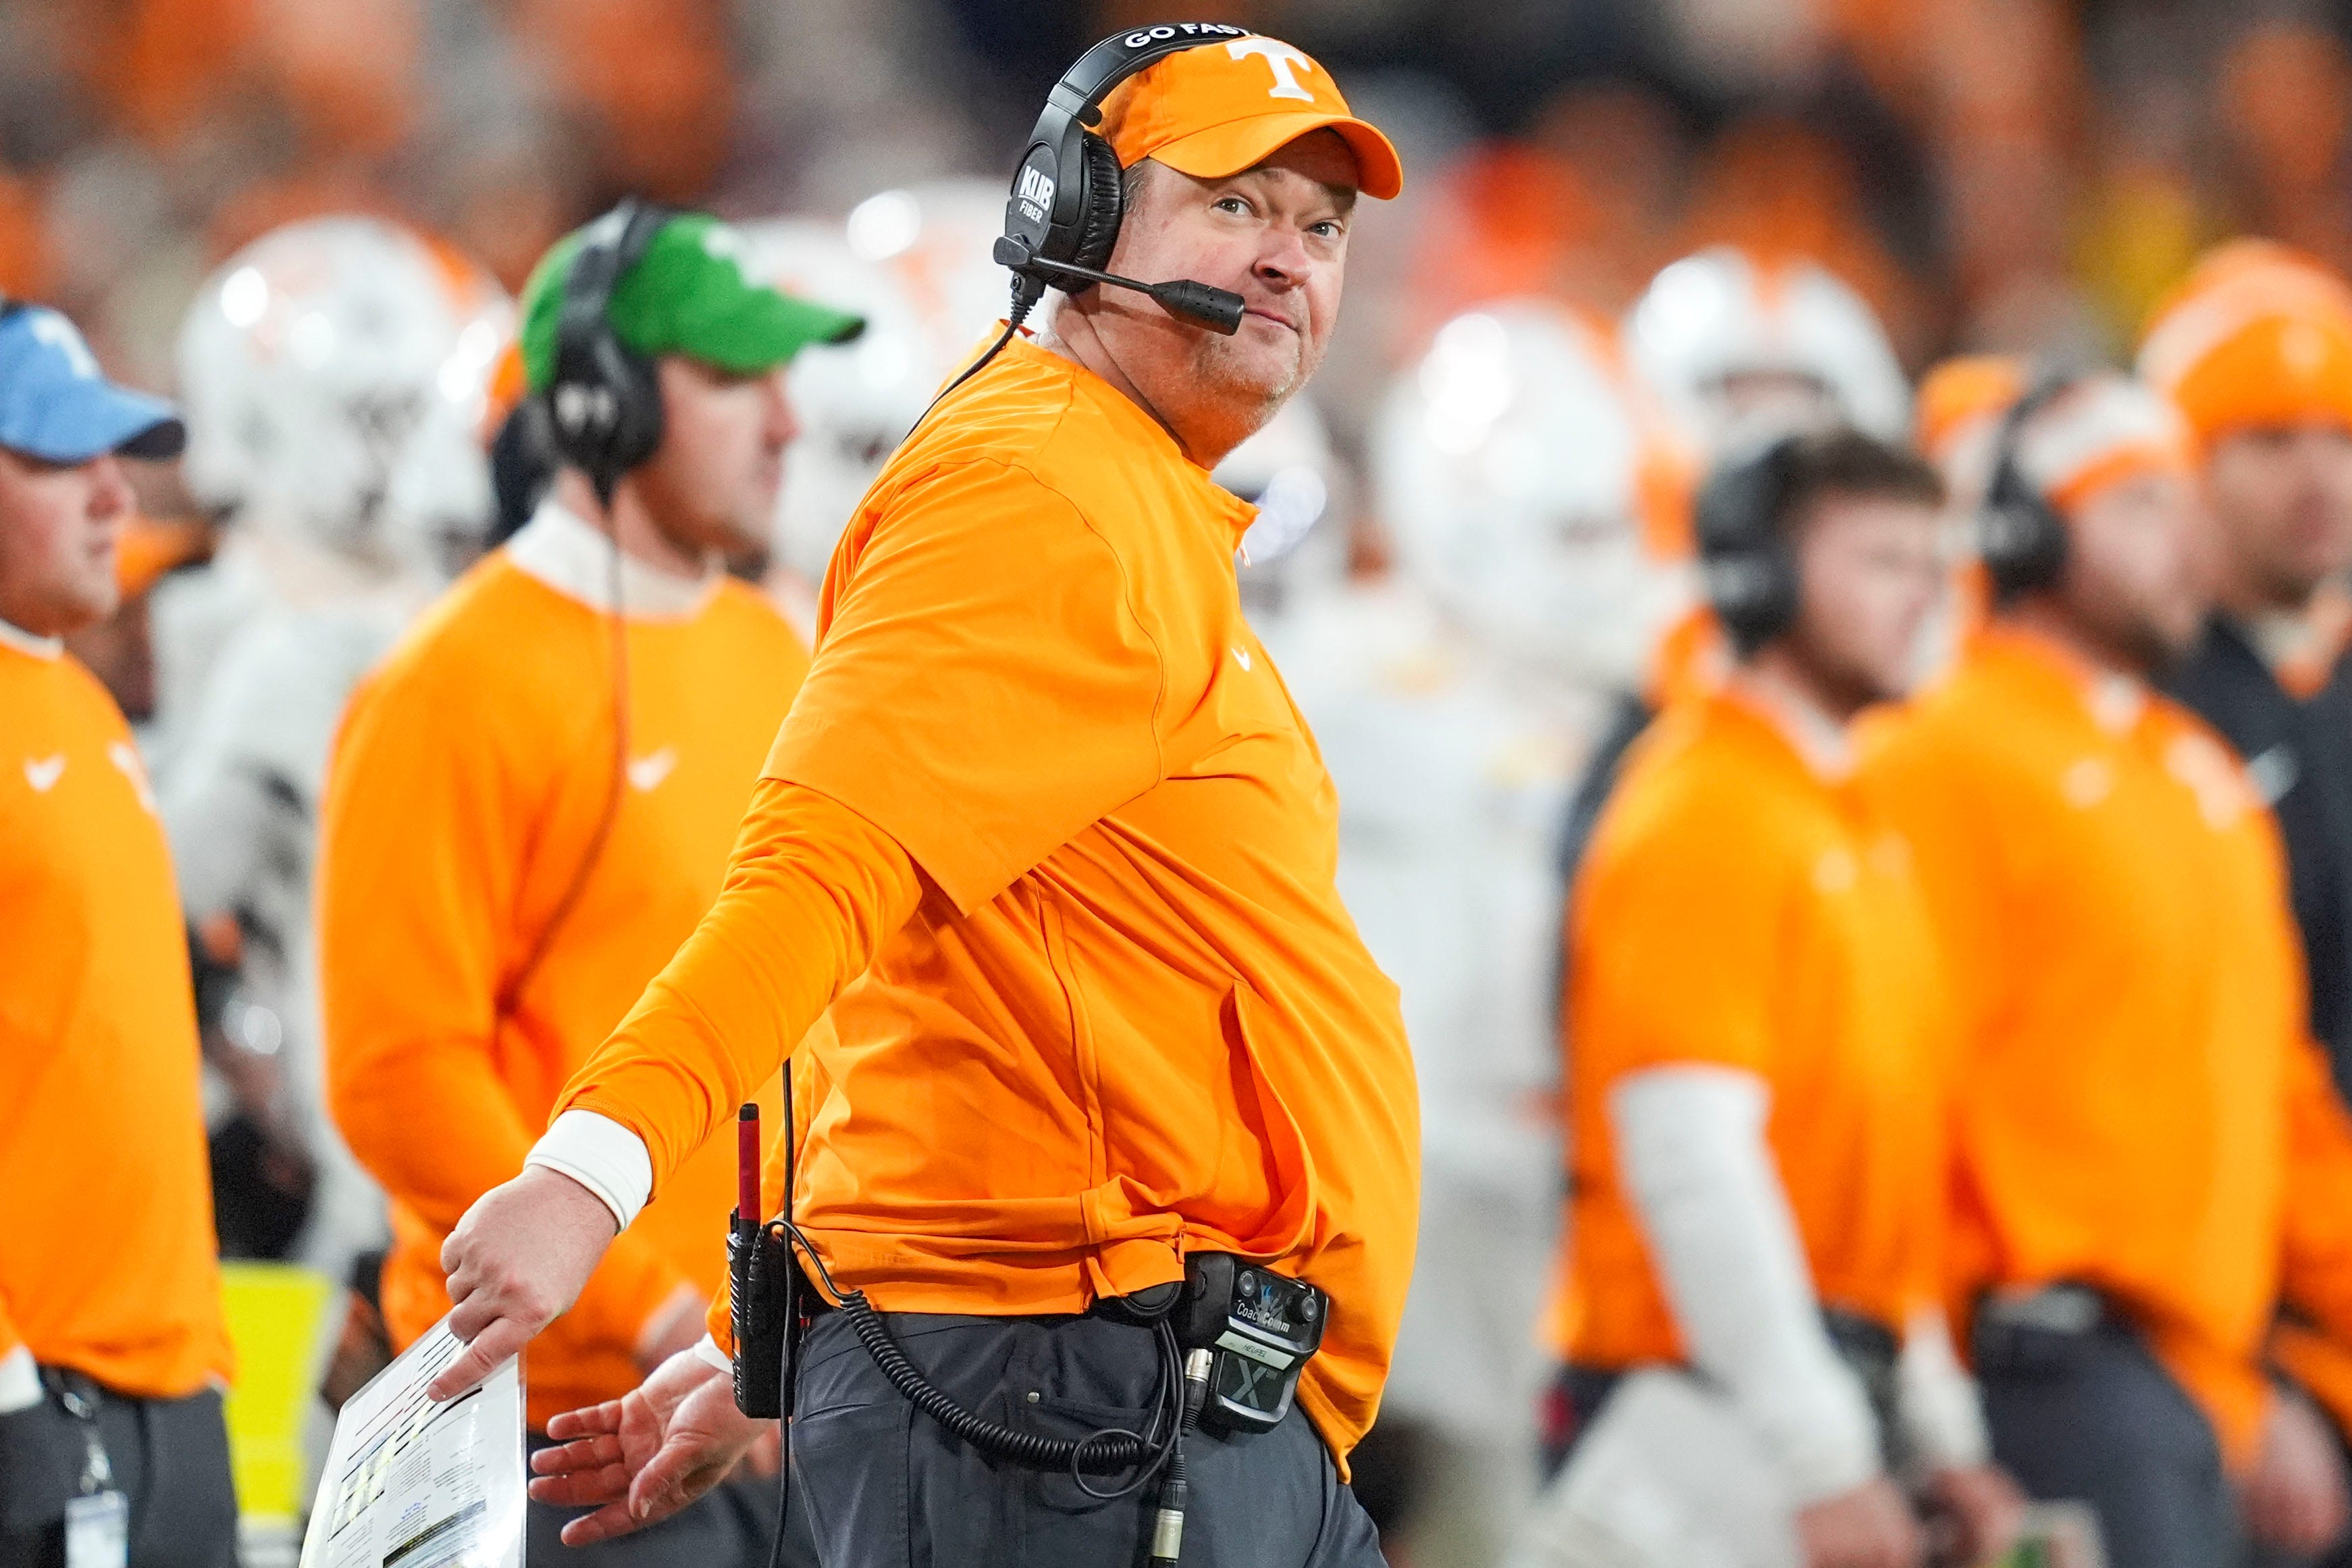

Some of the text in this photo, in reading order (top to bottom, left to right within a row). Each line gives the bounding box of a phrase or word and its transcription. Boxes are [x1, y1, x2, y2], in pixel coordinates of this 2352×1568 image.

[1124, 27, 1176, 48] GO
[1225, 38, 1315, 103] T
[1019, 165, 1054, 211] KUB
[1019, 200, 1043, 224] FIBER
